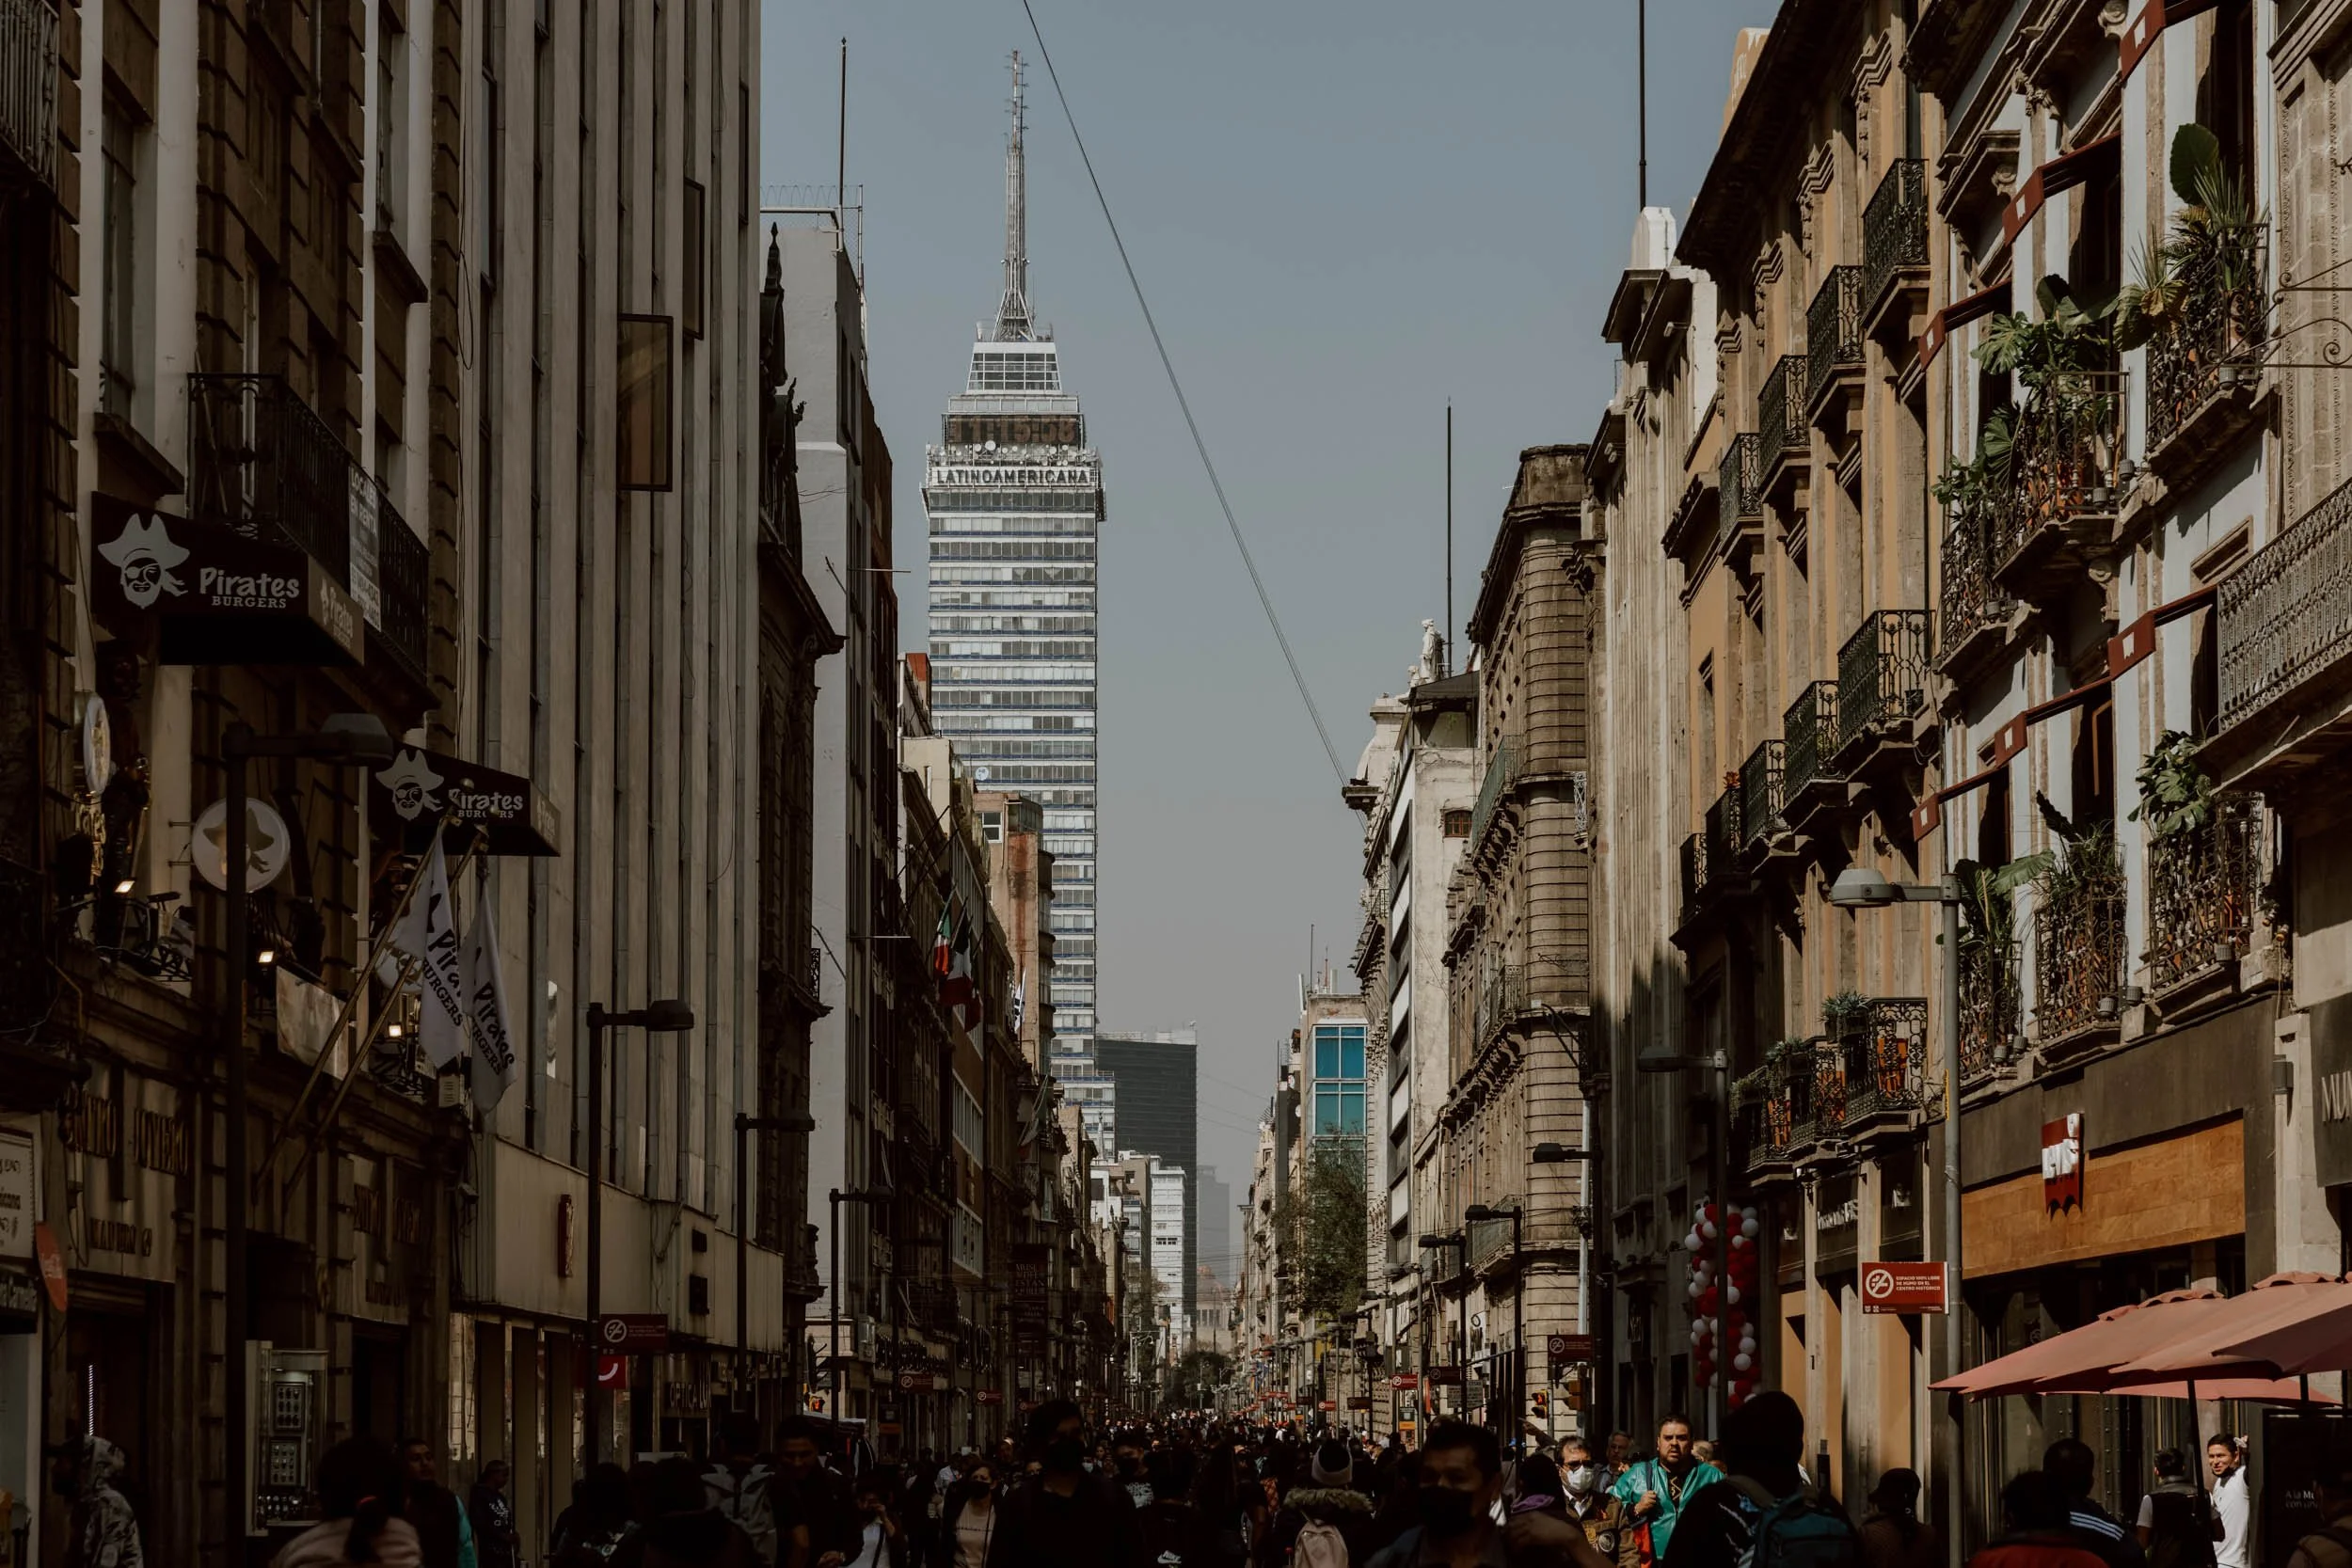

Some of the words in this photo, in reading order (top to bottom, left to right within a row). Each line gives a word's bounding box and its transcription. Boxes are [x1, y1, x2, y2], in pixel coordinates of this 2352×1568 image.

[937, 469, 1088, 484] LATINOAMERICANA
[199, 566, 300, 598] Pirates
[211, 595, 287, 610] BURGERS
[448, 787, 524, 811] Pirates
[473, 981, 515, 1069] Pirates
